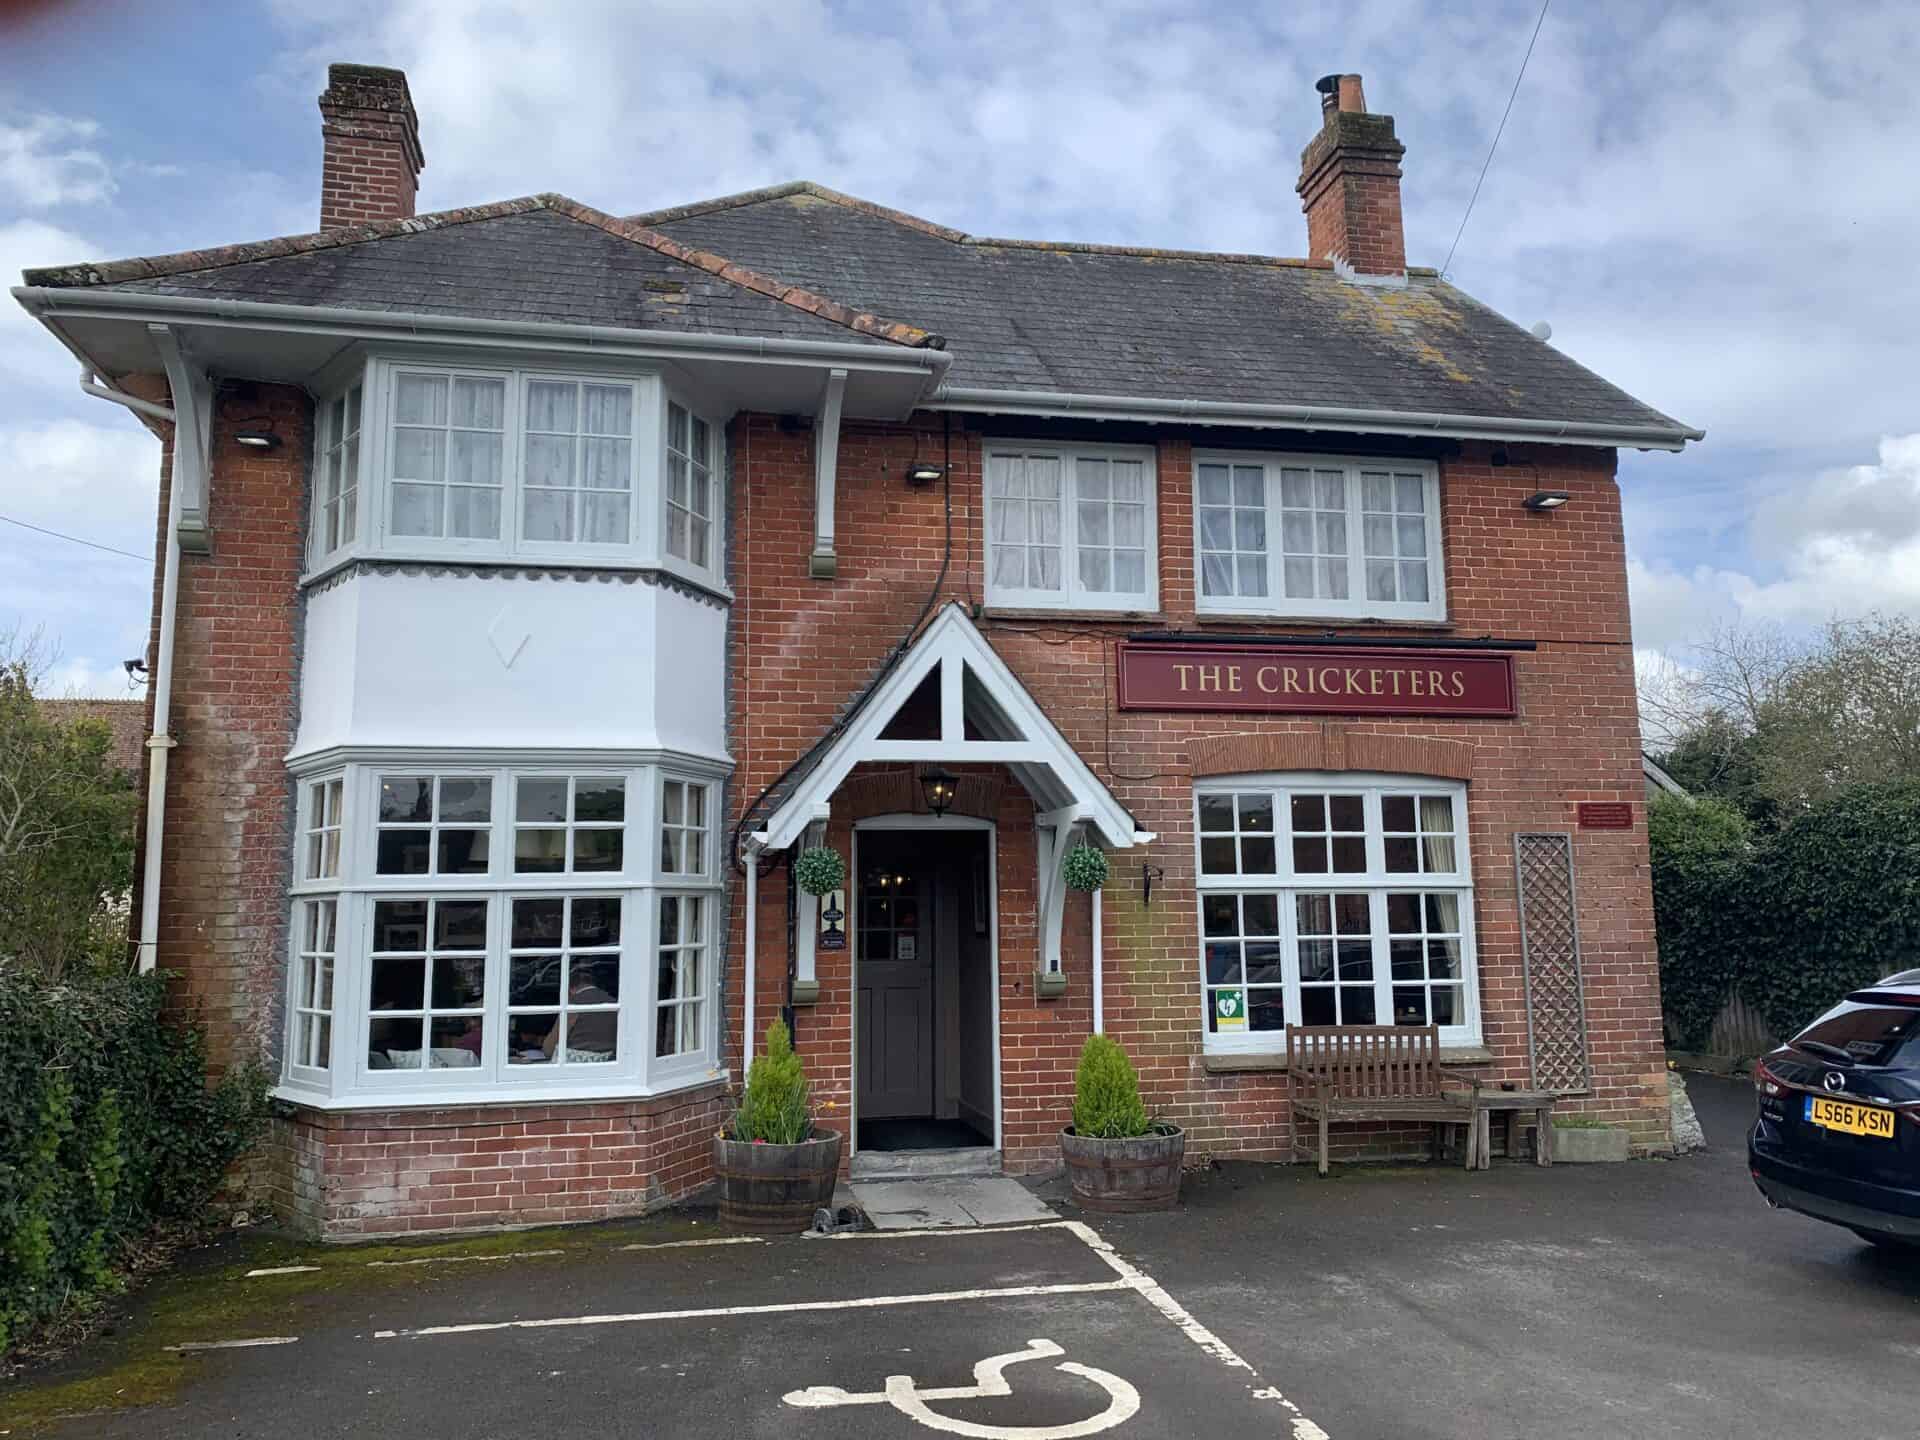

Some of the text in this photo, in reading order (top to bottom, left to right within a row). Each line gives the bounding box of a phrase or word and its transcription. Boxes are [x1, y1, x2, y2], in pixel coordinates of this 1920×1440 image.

[1172, 664, 1465, 697] THE CRICKETERS
[1814, 1100, 1890, 1133] LS66 KSN
